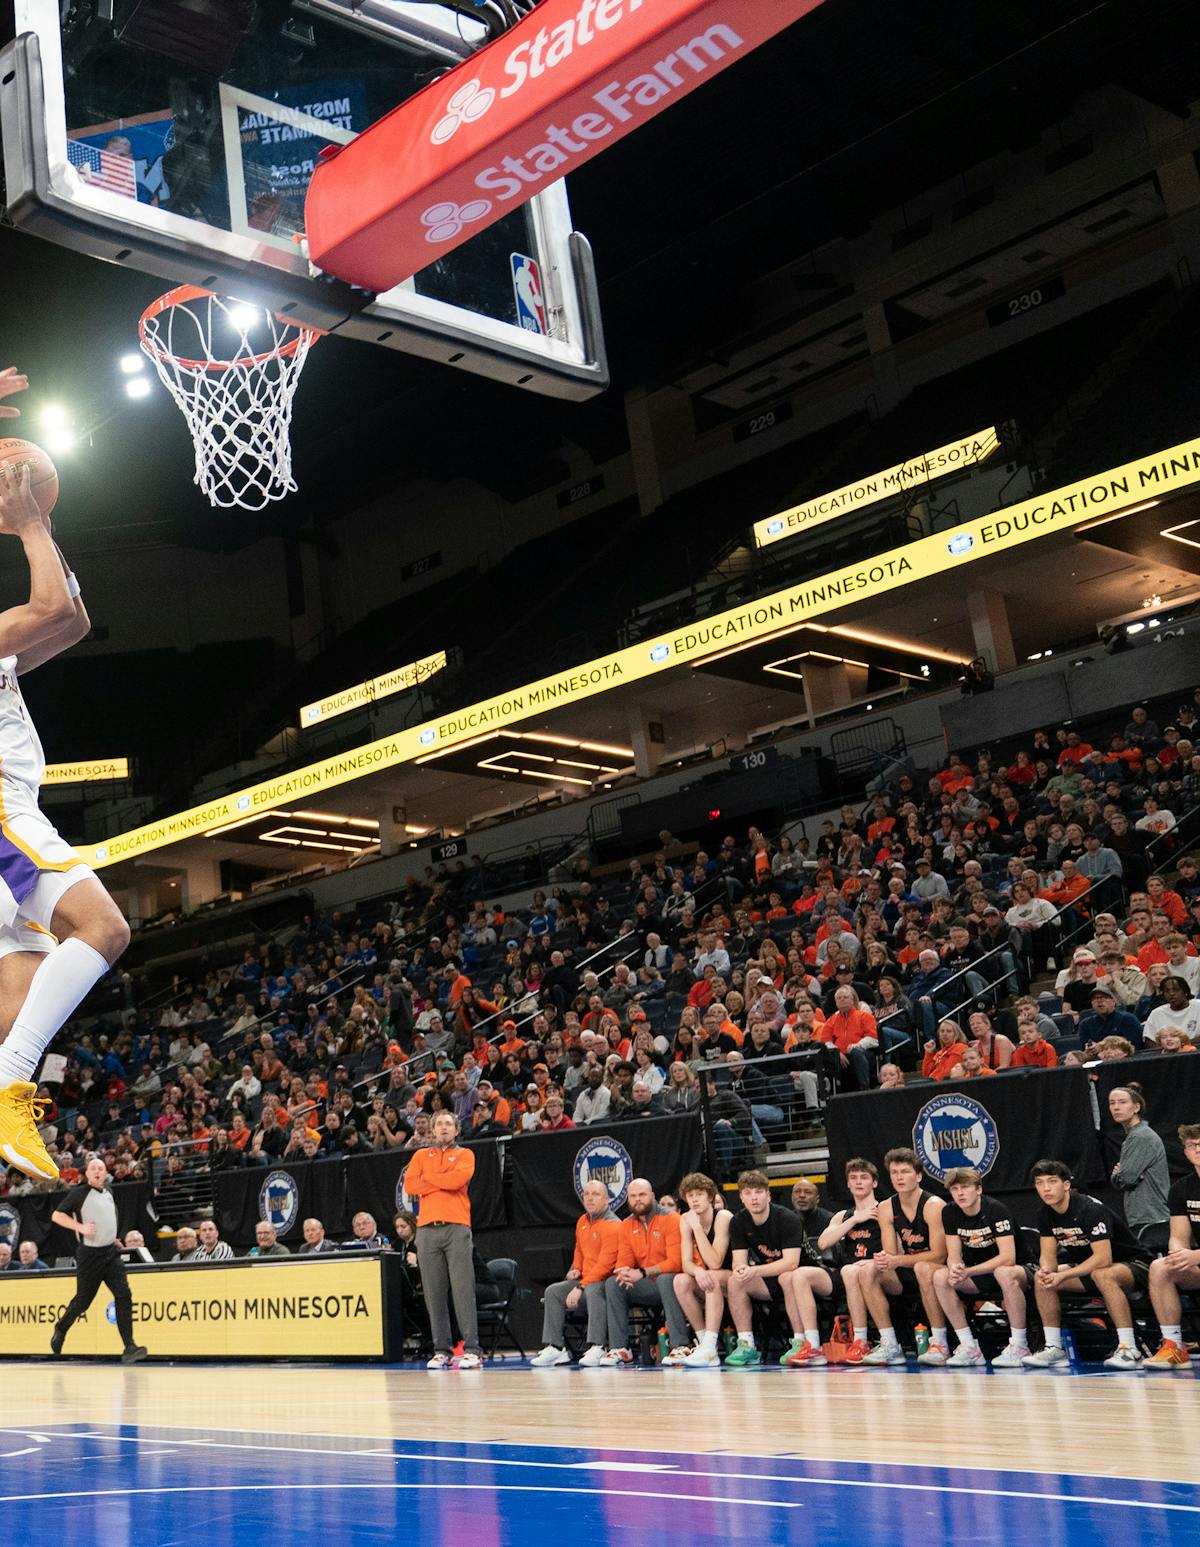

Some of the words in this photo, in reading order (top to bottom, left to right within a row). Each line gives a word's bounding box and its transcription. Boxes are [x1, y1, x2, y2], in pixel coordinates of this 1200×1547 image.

[500, 0, 644, 99] State
[474, 23, 745, 200] StateFarm
[1008, 289, 1043, 316] 230
[750, 411, 776, 435] 229
[786, 482, 878, 528] EDUCATION
[883, 440, 983, 489] MINNESOTA
[981, 477, 1130, 544] EDUCATION
[674, 603, 783, 654] EDUCATION
[789, 557, 912, 612] MINNESOTA
[321, 685, 376, 714] EDUCATION
[379, 660, 438, 690] MINNESOTA
[439, 697, 524, 738] EDUCATION
[528, 662, 623, 707] MINNESOTA
[46, 764, 117, 777] MINNESOTA
[742, 751, 766, 770] 130
[252, 771, 322, 805] EDUCATION
[325, 744, 399, 779] MINNESOTA
[109, 829, 166, 857] EDUCATION
[168, 804, 230, 837] MINNESOTA
[440, 843, 458, 858] 129
[922, 1096, 980, 1120] MINNESOTA
[580, 1140, 623, 1159] MINNESOTA
[930, 1127, 979, 1152] MSHSL
[587, 1166, 621, 1184] MSHSL
[995, 1219, 1011, 1233] 30
[1091, 1222, 1107, 1236] 30
[131, 1299, 237, 1323] EDUCATION
[244, 1295, 370, 1320] MINNESOTA
